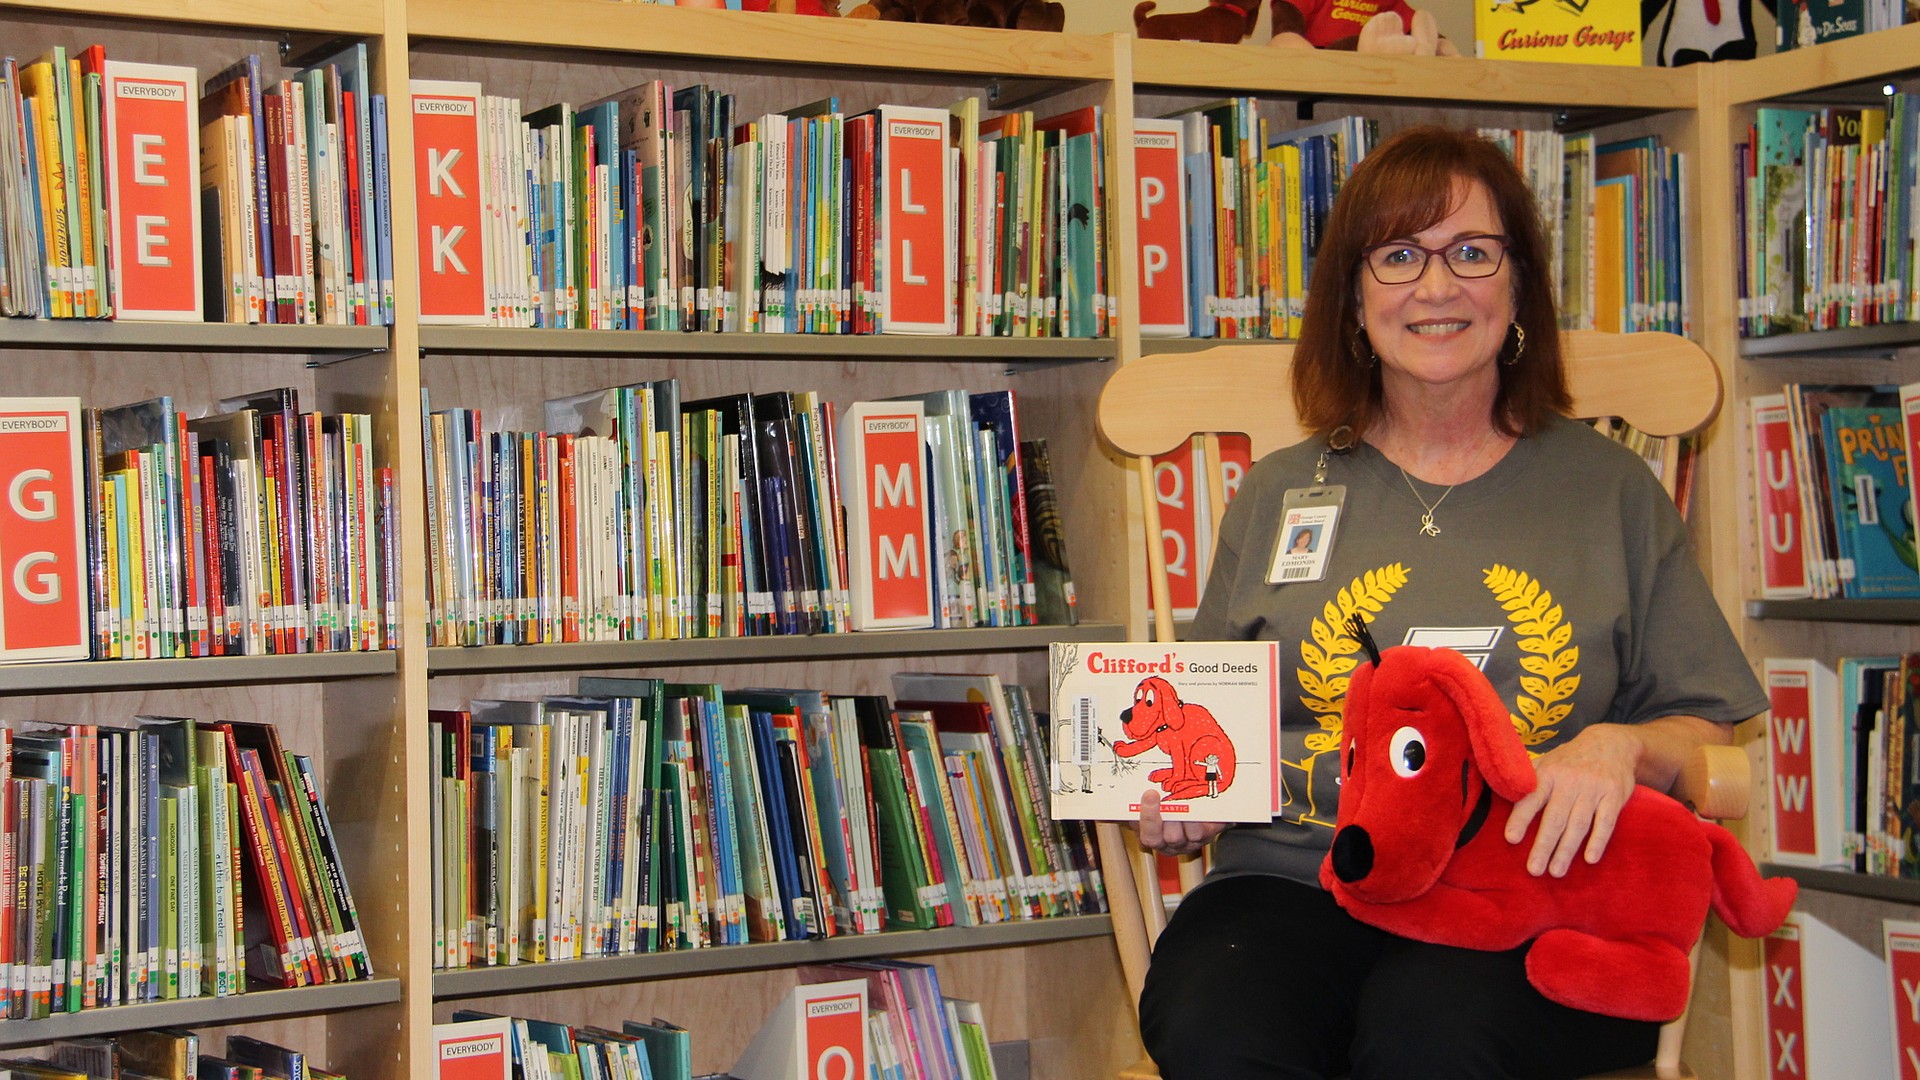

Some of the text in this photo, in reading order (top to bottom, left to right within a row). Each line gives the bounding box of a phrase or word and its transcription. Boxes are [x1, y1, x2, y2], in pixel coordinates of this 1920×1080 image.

[1497, 25, 1635, 51] Curious George
[1822, 21, 1835, 38] Dr.
[1835, 16, 1857, 33] Seuss
[123, 86, 177, 97] EVERYBODY
[419, 103, 468, 113] EVERYBODY
[364, 117, 372, 179] GINGERBREAD
[894, 126, 935, 136] EVERYBODY
[133, 134, 167, 186] E
[428, 148, 466, 198] K
[300, 154, 310, 219] THANKSGIVING
[901, 168, 927, 214] L
[1140, 176, 1165, 220] P
[136, 215, 171, 266] E
[304, 222, 312, 238] DAY
[305, 242, 314, 275] THANKS
[431, 225, 469, 274] K
[902, 239, 928, 285] L
[1143, 244, 1169, 288] P
[2, 420, 58, 430] EVERYBODY
[812, 407, 821, 431] Playing
[869, 421, 909, 431] EVERYBODY
[191, 442, 199, 467] Garton
[814, 434, 822, 443] by
[874, 463, 916, 510] M
[1154, 461, 1185, 510] Q
[1766, 449, 1791, 490] U
[9, 468, 57, 522] G
[194, 506, 202, 533] OTTER
[429, 520, 437, 555] FREEDOM
[519, 517, 526, 526] AT
[1769, 513, 1794, 554] U
[878, 533, 921, 580] M
[1161, 529, 1188, 577] Q
[14, 551, 62, 604] G
[1087, 652, 1258, 674] Clifford's Good Deeds
[1774, 717, 1806, 755] W
[63, 752, 71, 770] Hills
[20, 790, 28, 819] HIGGINS
[1776, 774, 1808, 812] W
[595, 807, 603, 848] ALLIGATOR
[618, 795, 628, 862] WONDER HORSE
[727, 800, 741, 881] Someplace Special
[58, 803, 70, 905] How Rocket Learned Read
[98, 853, 106, 878] ZOMBIES
[215, 861, 224, 883] Letter
[18, 866, 29, 909] BE QUIET!
[36, 870, 44, 897] HOTEL
[98, 880, 106, 892] AND
[262, 843, 293, 940] The Three Tuff
[592, 874, 599, 883] MY
[217, 908, 225, 938] Teacher
[236, 896, 244, 929] OREGON
[1771, 964, 1795, 1009] X
[812, 1001, 854, 1014] EVERYBODY
[446, 1041, 495, 1056] EVERYBODY
[1775, 1029, 1798, 1075] X
